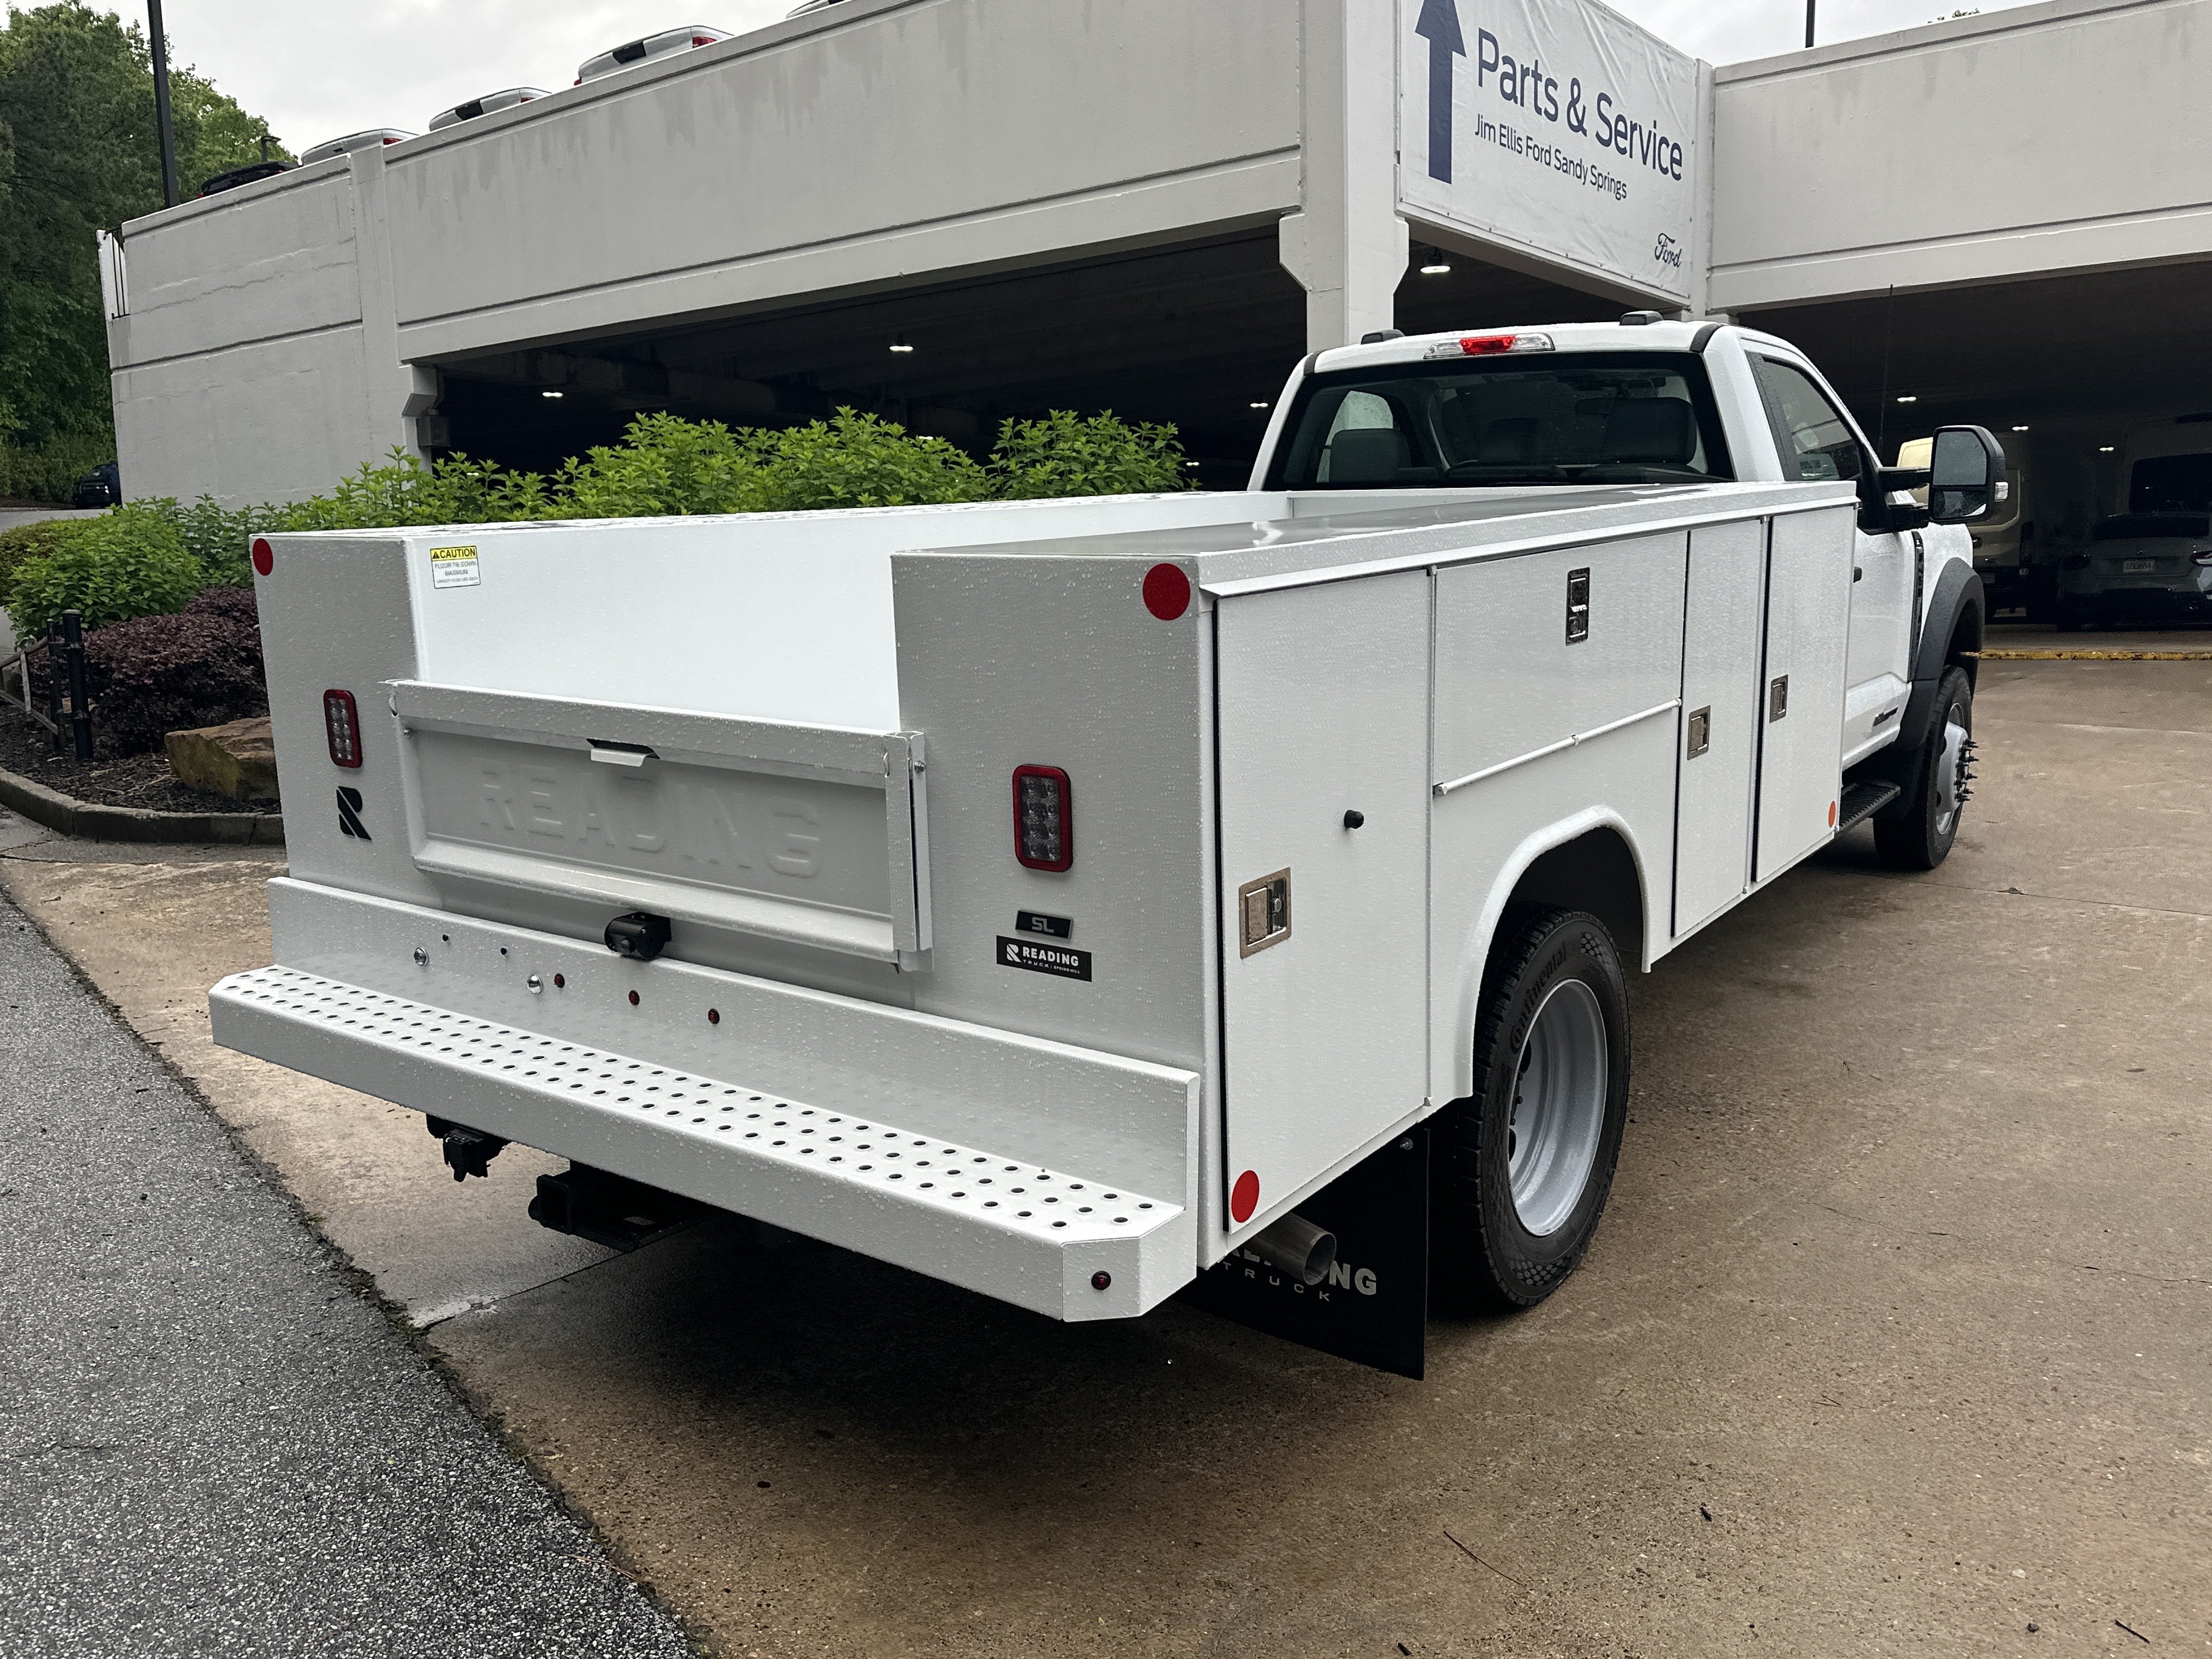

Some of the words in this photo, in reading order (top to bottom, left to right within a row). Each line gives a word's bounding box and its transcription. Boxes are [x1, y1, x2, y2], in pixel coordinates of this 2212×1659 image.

[1479, 27, 1559, 122] Parts
[1566, 77, 1588, 137] &
[1595, 92, 1683, 181] Service
[1475, 114, 1497, 144] Jim
[1499, 123, 1523, 155] Ellis
[1526, 136, 1551, 167] Ford
[1554, 148, 1588, 186] Sandy
[1590, 165, 1627, 201] Springs
[1654, 233, 1682, 269] Ford
[439, 548, 476, 558] CAUTION
[479, 764, 821, 879] READING
[1031, 916, 1054, 933] SL
[1022, 946, 1079, 967] READING
[1023, 959, 1049, 968] TRUCK
[1222, 1261, 1330, 1302] TRUCK
